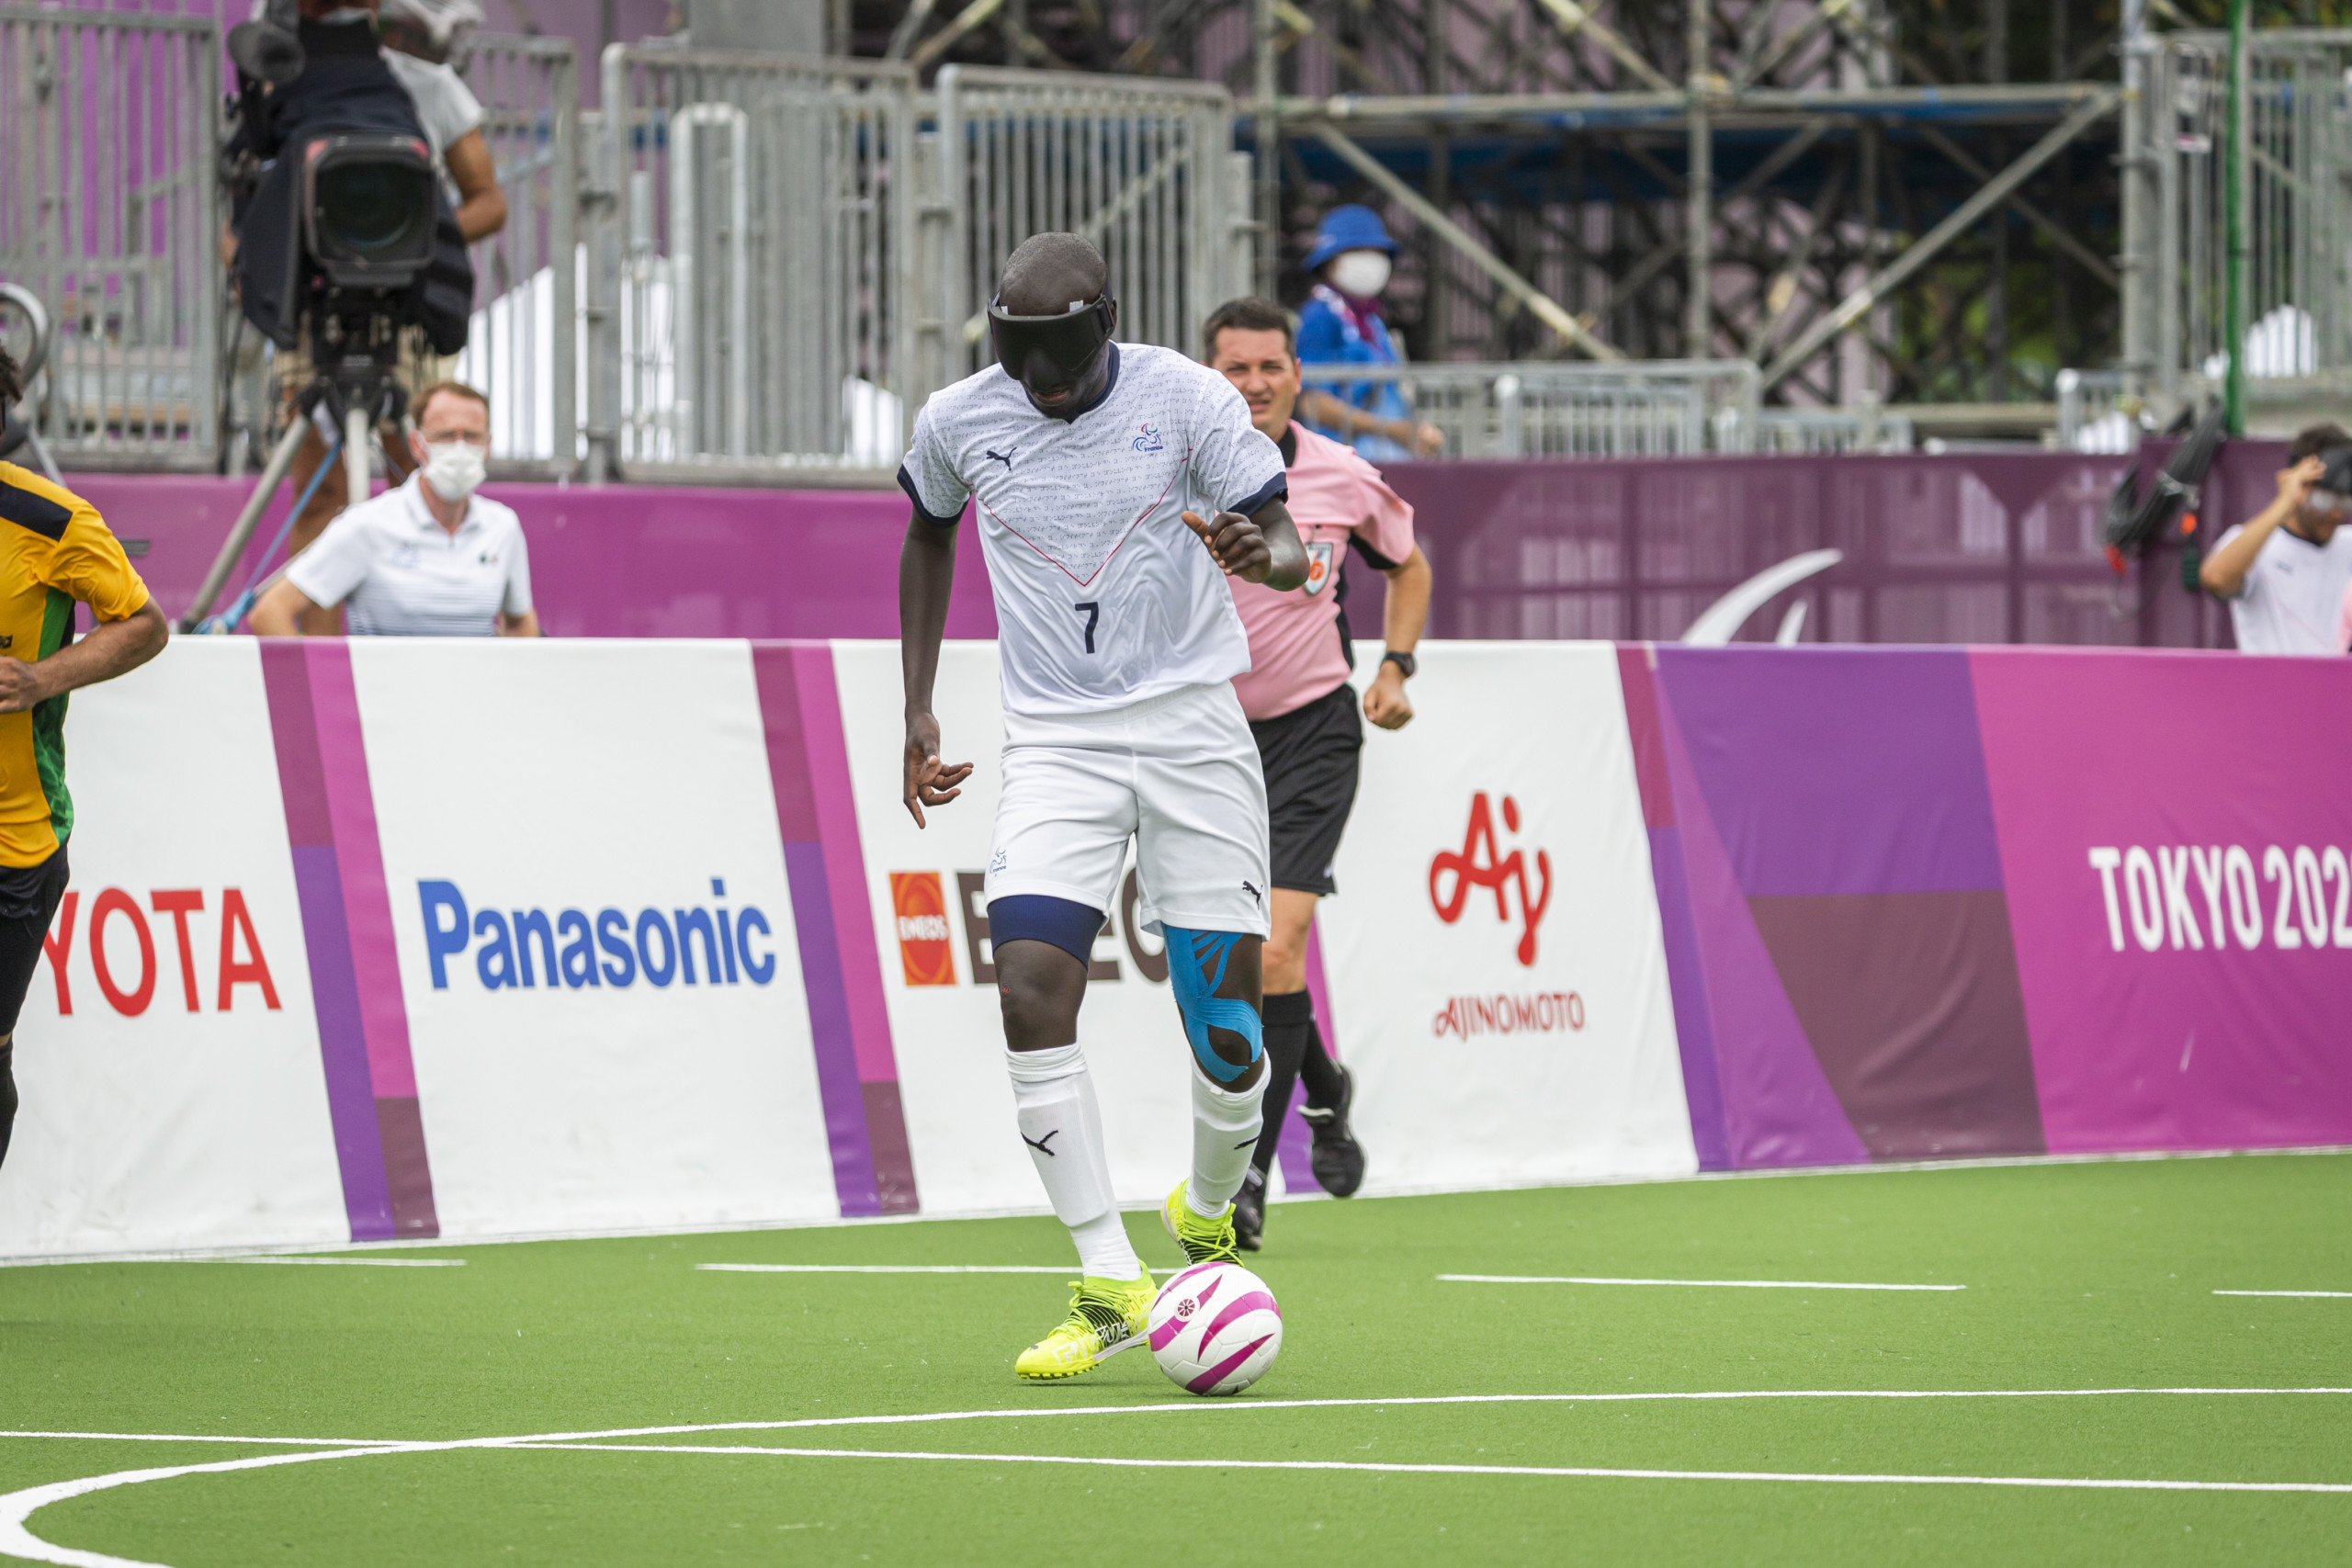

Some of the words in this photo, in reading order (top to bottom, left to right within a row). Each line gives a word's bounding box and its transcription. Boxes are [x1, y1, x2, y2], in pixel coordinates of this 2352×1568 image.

[1074, 601, 1100, 655] 7
[42, 886, 283, 1018] YOTA
[416, 877, 776, 991] Panasonic
[2088, 843, 2263, 953] TOKYO
[2263, 844, 2352, 950] 202
[1434, 991, 1585, 1043] AJINOMOTO
